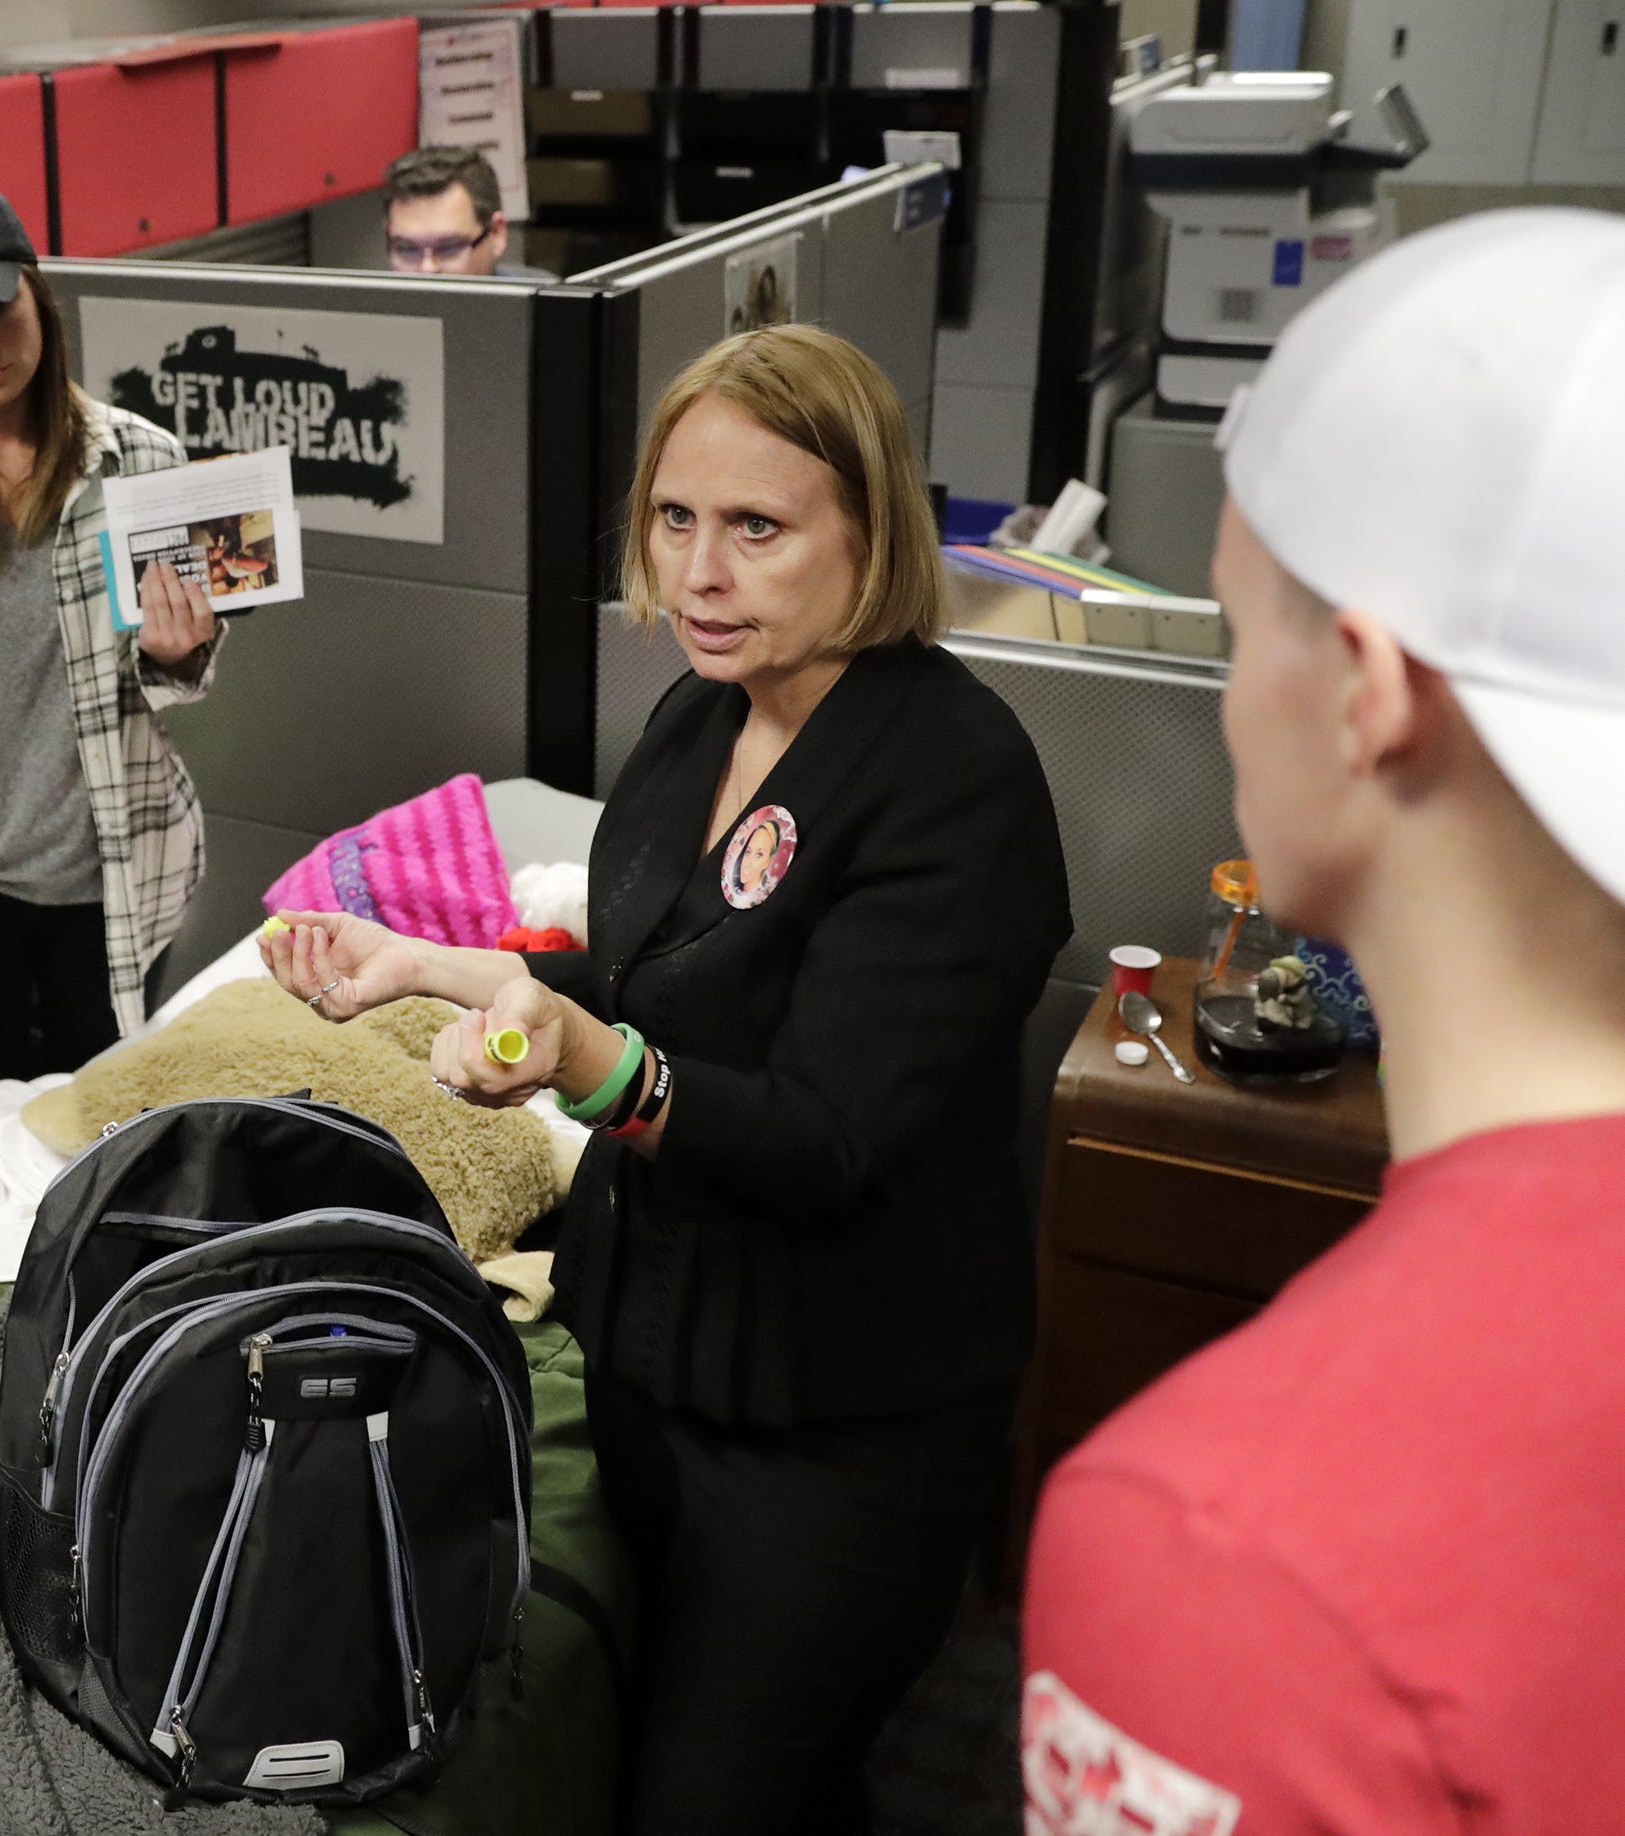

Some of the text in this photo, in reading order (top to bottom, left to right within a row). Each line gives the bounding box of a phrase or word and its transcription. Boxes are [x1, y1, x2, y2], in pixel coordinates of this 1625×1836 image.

[151, 370, 335, 424] GET LOUD
[176, 400, 398, 466] LAMBEAU
[654, 1064, 671, 1098] Stop
